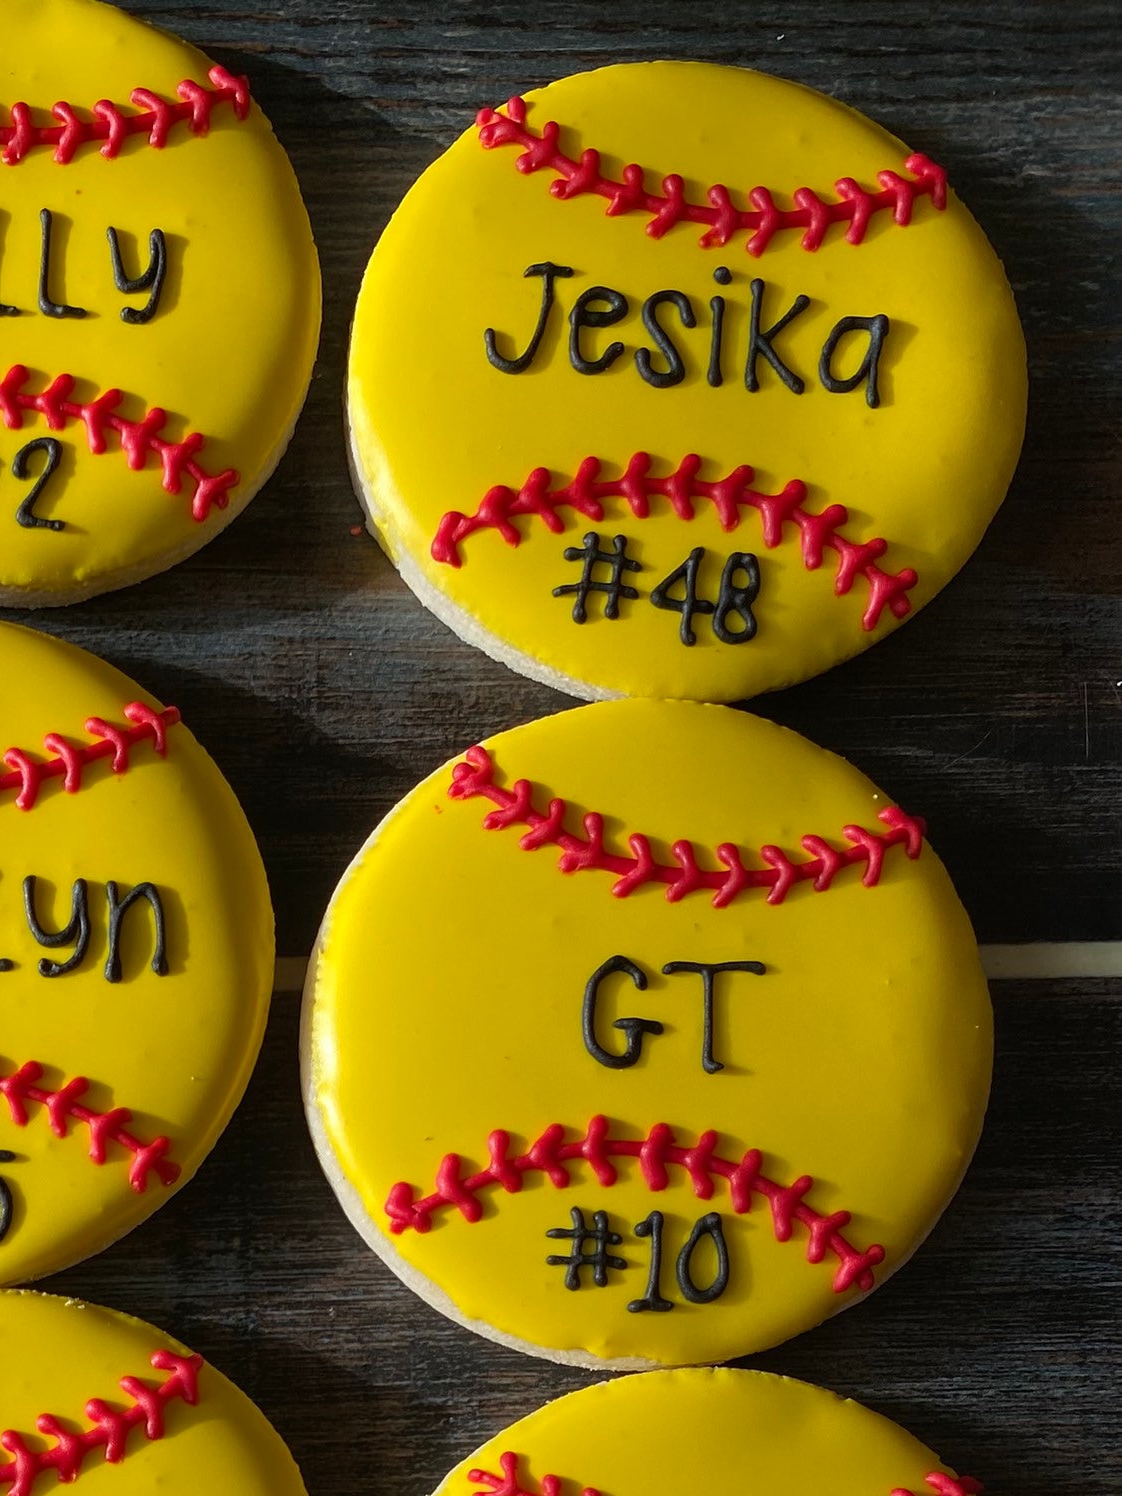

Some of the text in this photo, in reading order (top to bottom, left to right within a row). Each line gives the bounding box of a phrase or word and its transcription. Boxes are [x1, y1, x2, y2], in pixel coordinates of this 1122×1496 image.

[553, 530, 767, 647] #48
[583, 953, 768, 1075] GT
[545, 1205, 738, 1314] #10
